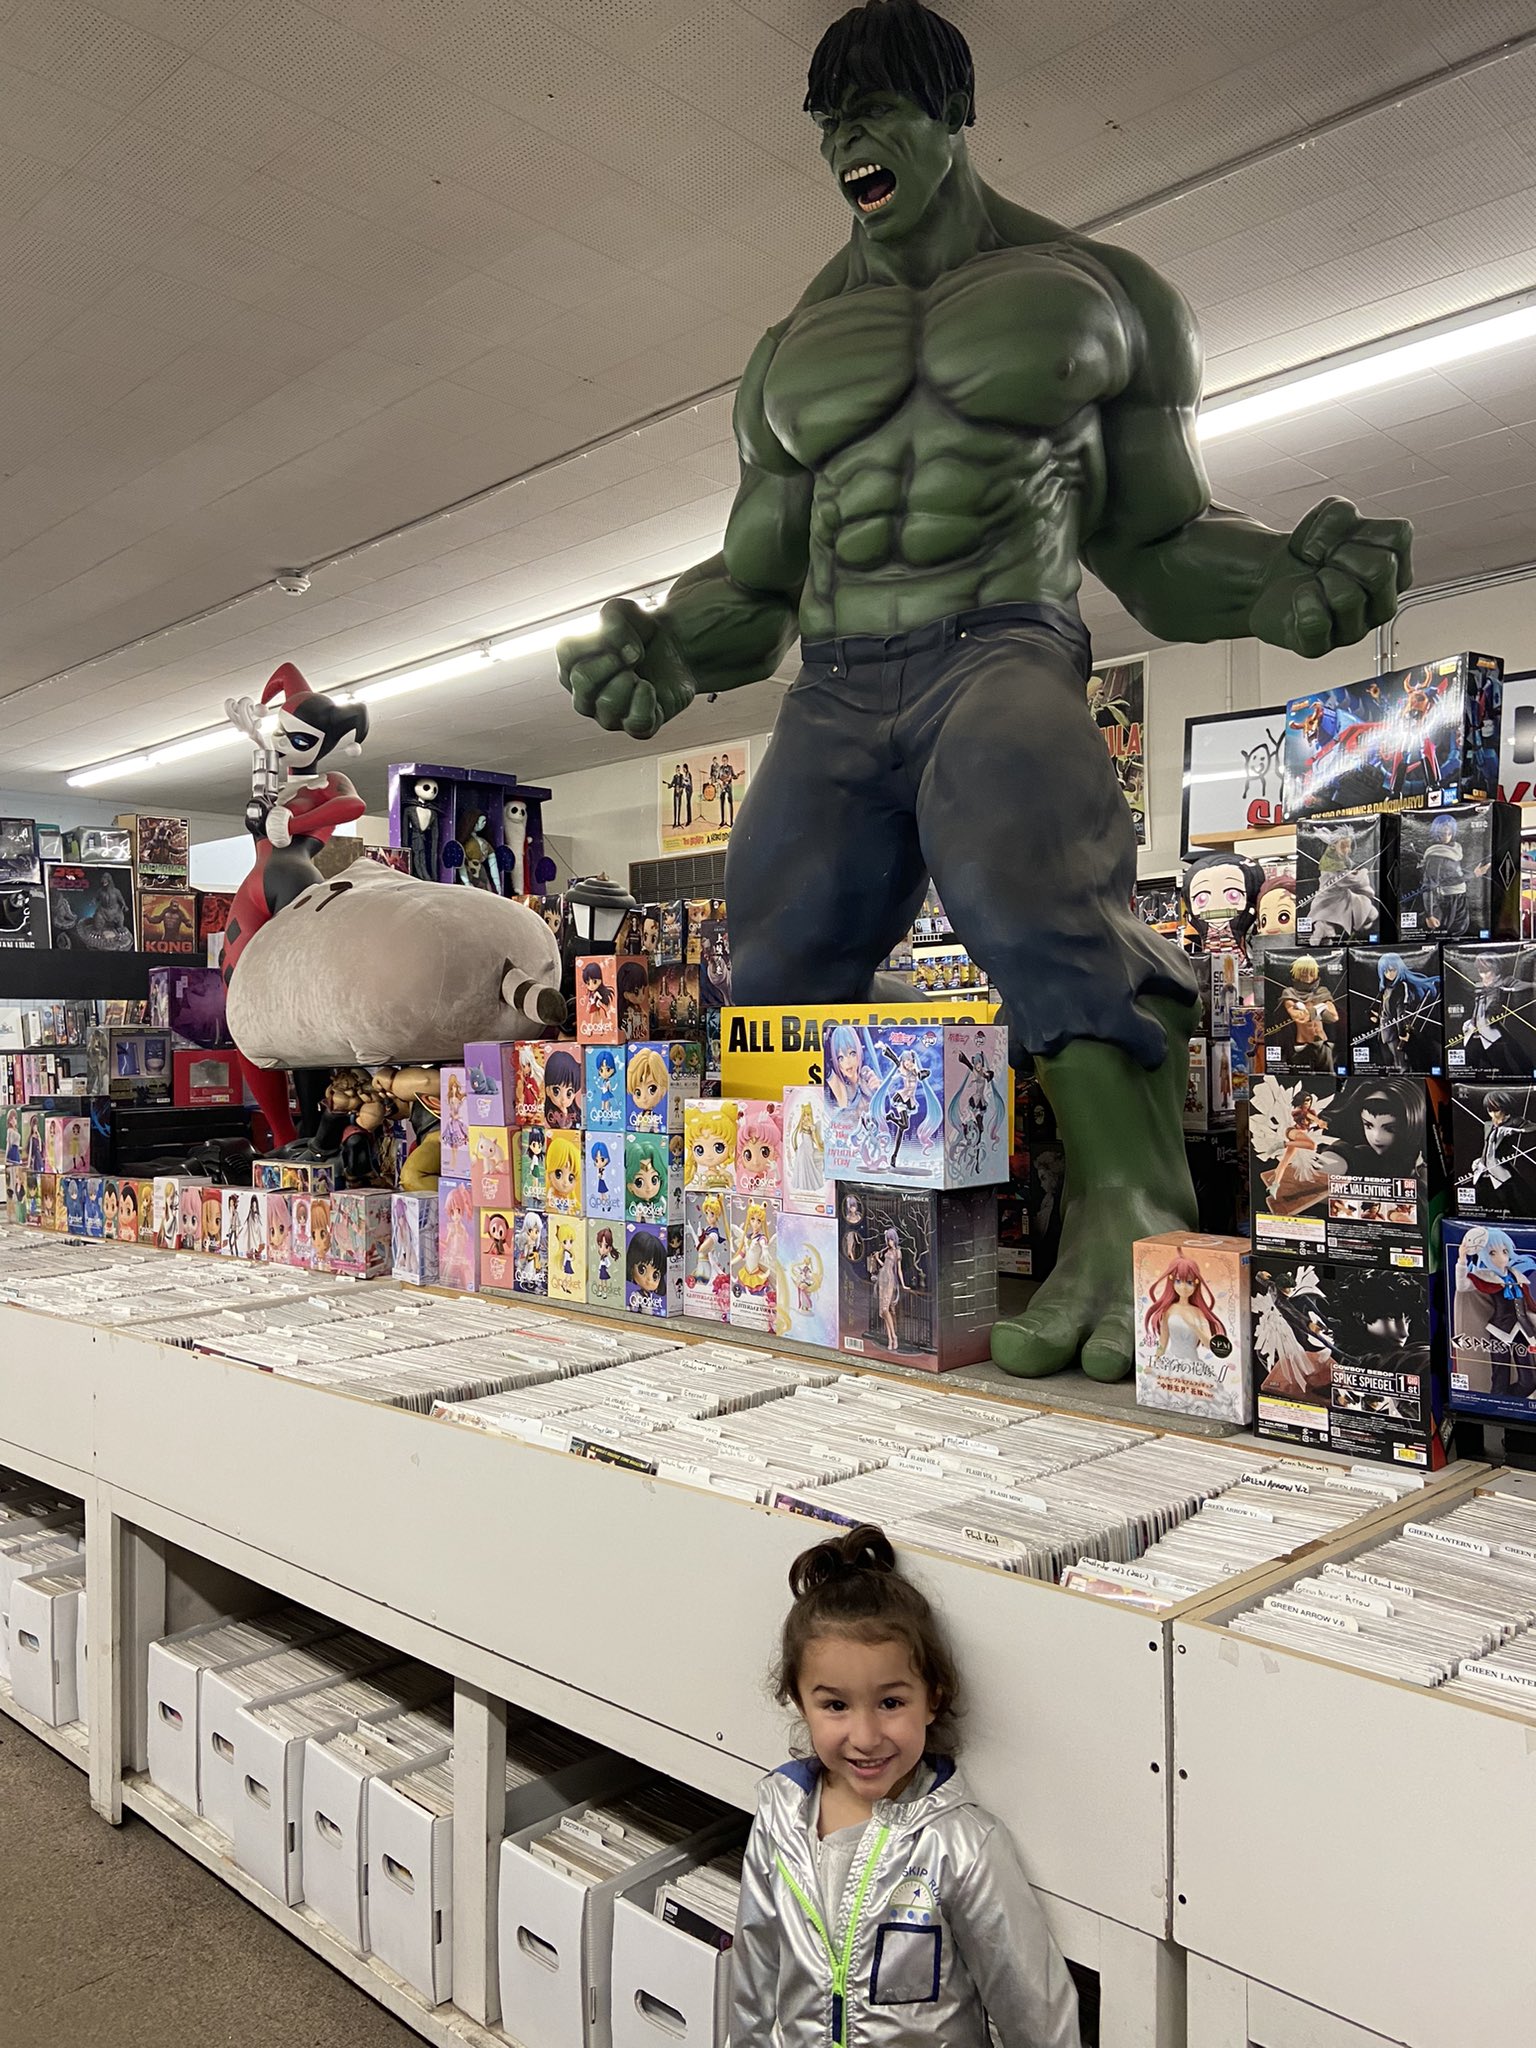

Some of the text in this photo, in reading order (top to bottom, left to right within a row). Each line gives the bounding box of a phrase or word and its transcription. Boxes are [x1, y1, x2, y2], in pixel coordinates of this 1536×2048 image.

[145, 941, 193, 952] KONG
[729, 1016, 774, 1053] ALL
[1330, 1182, 1391, 1197] FAYE VALENTINE
[1211, 1339, 1230, 1350] SPM
[1333, 1371, 1394, 1392] SPIKE SPIEGEL
[990, 1489, 1008, 1500] FLASH
[1204, 1502, 1225, 1512] GREEN
[1408, 1528, 1434, 1539] GREEN
[1435, 1534, 1472, 1549] LANTERN
[1504, 1546, 1532, 1557] GREEN
[1270, 1600, 1346, 1628] GREEN ARROW V.6
[1465, 1664, 1498, 1679] GREEN
[901, 1866, 928, 1878] SKIP
